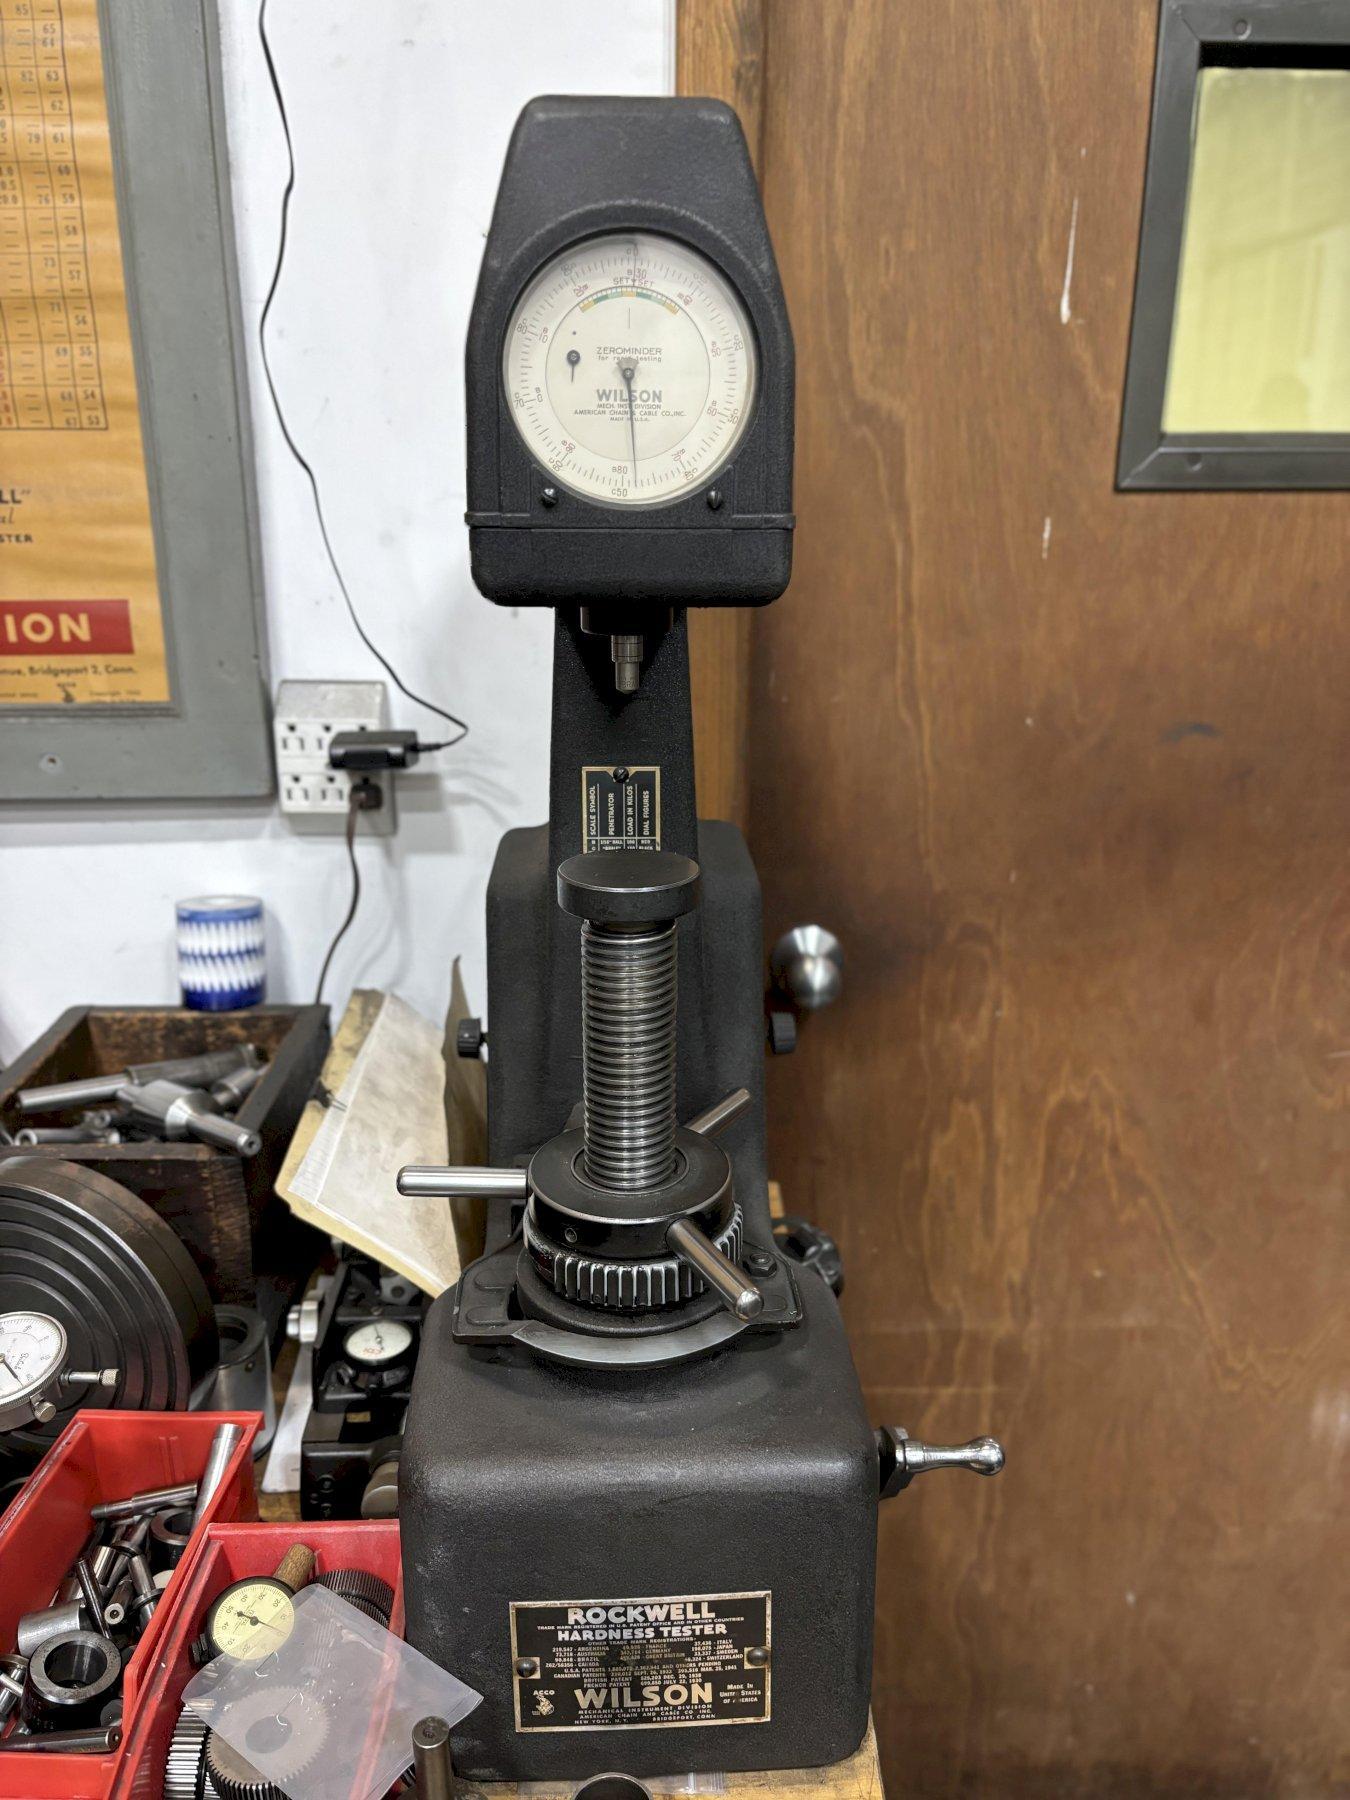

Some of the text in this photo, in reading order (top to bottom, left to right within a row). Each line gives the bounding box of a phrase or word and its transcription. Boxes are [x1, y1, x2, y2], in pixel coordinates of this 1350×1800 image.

[42, 23, 56, 34] 65
[46, 70, 60, 82] 63
[51, 100, 64, 111] 62
[27, 132, 65, 143] 79 61
[62, 192, 75, 204] 59
[68, 270, 81, 281] 57
[74, 315, 87, 326] 56
[596, 346, 663, 355] ZEROMINDER
[83, 389, 96, 400] 54
[597, 389, 662, 403] WILSON
[4, 613, 92, 644] ION
[29, 665, 88, 678] Bridgeport
[607, 792, 615, 836] PENETRATOR
[627, 807, 634, 816] IN
[589, 814, 597, 836] SCALE
[567, 1602, 716, 1625] ROCKWELL
[557, 1623, 728, 1642] HARDNESS TESTER
[706, 1653, 744, 1661] SWITZERLAND
[574, 1682, 713, 1709] WILSON
